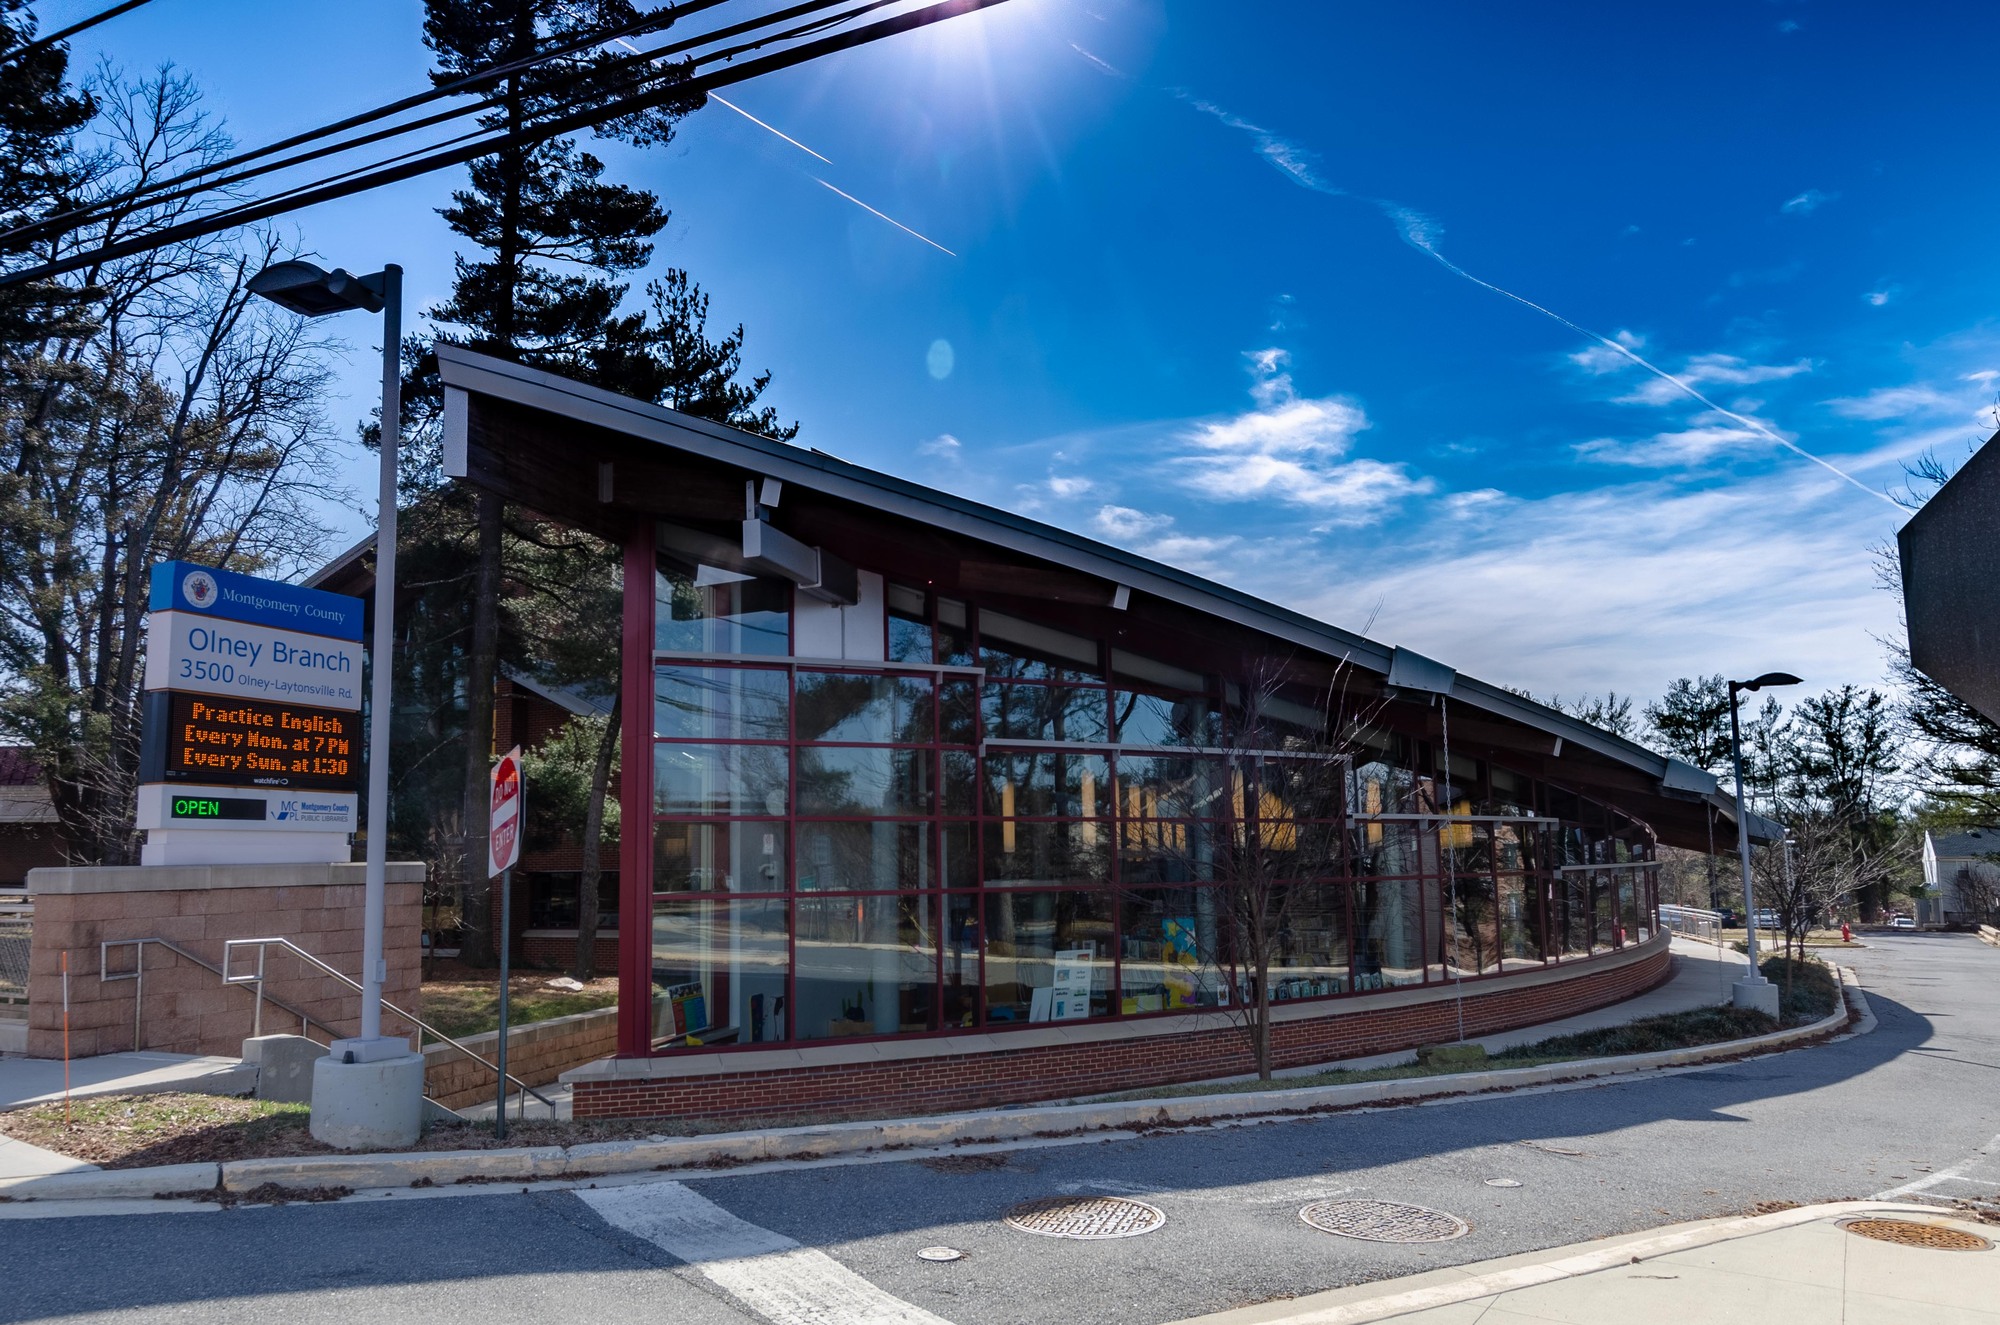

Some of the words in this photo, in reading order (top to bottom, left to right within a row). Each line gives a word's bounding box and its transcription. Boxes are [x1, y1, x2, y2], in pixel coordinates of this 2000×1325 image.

[223, 588, 301, 617] Montgomery
[305, 605, 346, 625] County
[189, 628, 262, 667] Olney
[273, 641, 350, 673] Branch
[180, 658, 234, 683] 3500
[238, 674, 335, 697] Olney-Laytonsville
[338, 688, 353, 699] Rd.
[192, 702, 274, 727] Practice
[281, 712, 343, 734] English
[184, 724, 243, 748] Every
[247, 730, 288, 750] Mon.
[292, 737, 310, 751] at
[314, 736, 325, 752] 7
[328, 737, 349, 755] PM
[183, 747, 242, 770] Every
[246, 752, 287, 771] Sun.
[291, 758, 309, 773] at
[312, 757, 348, 775] 1:30
[281, 800, 299, 812] MC
[496, 784, 503, 803] DO
[175, 800, 219, 816] OPEN
[289, 812, 299, 821] PL
[301, 802, 332, 813] Montgomery
[332, 803, 350, 813] County
[321, 815, 349, 823] LIBRARIES
[496, 824, 514, 851] ENTER
